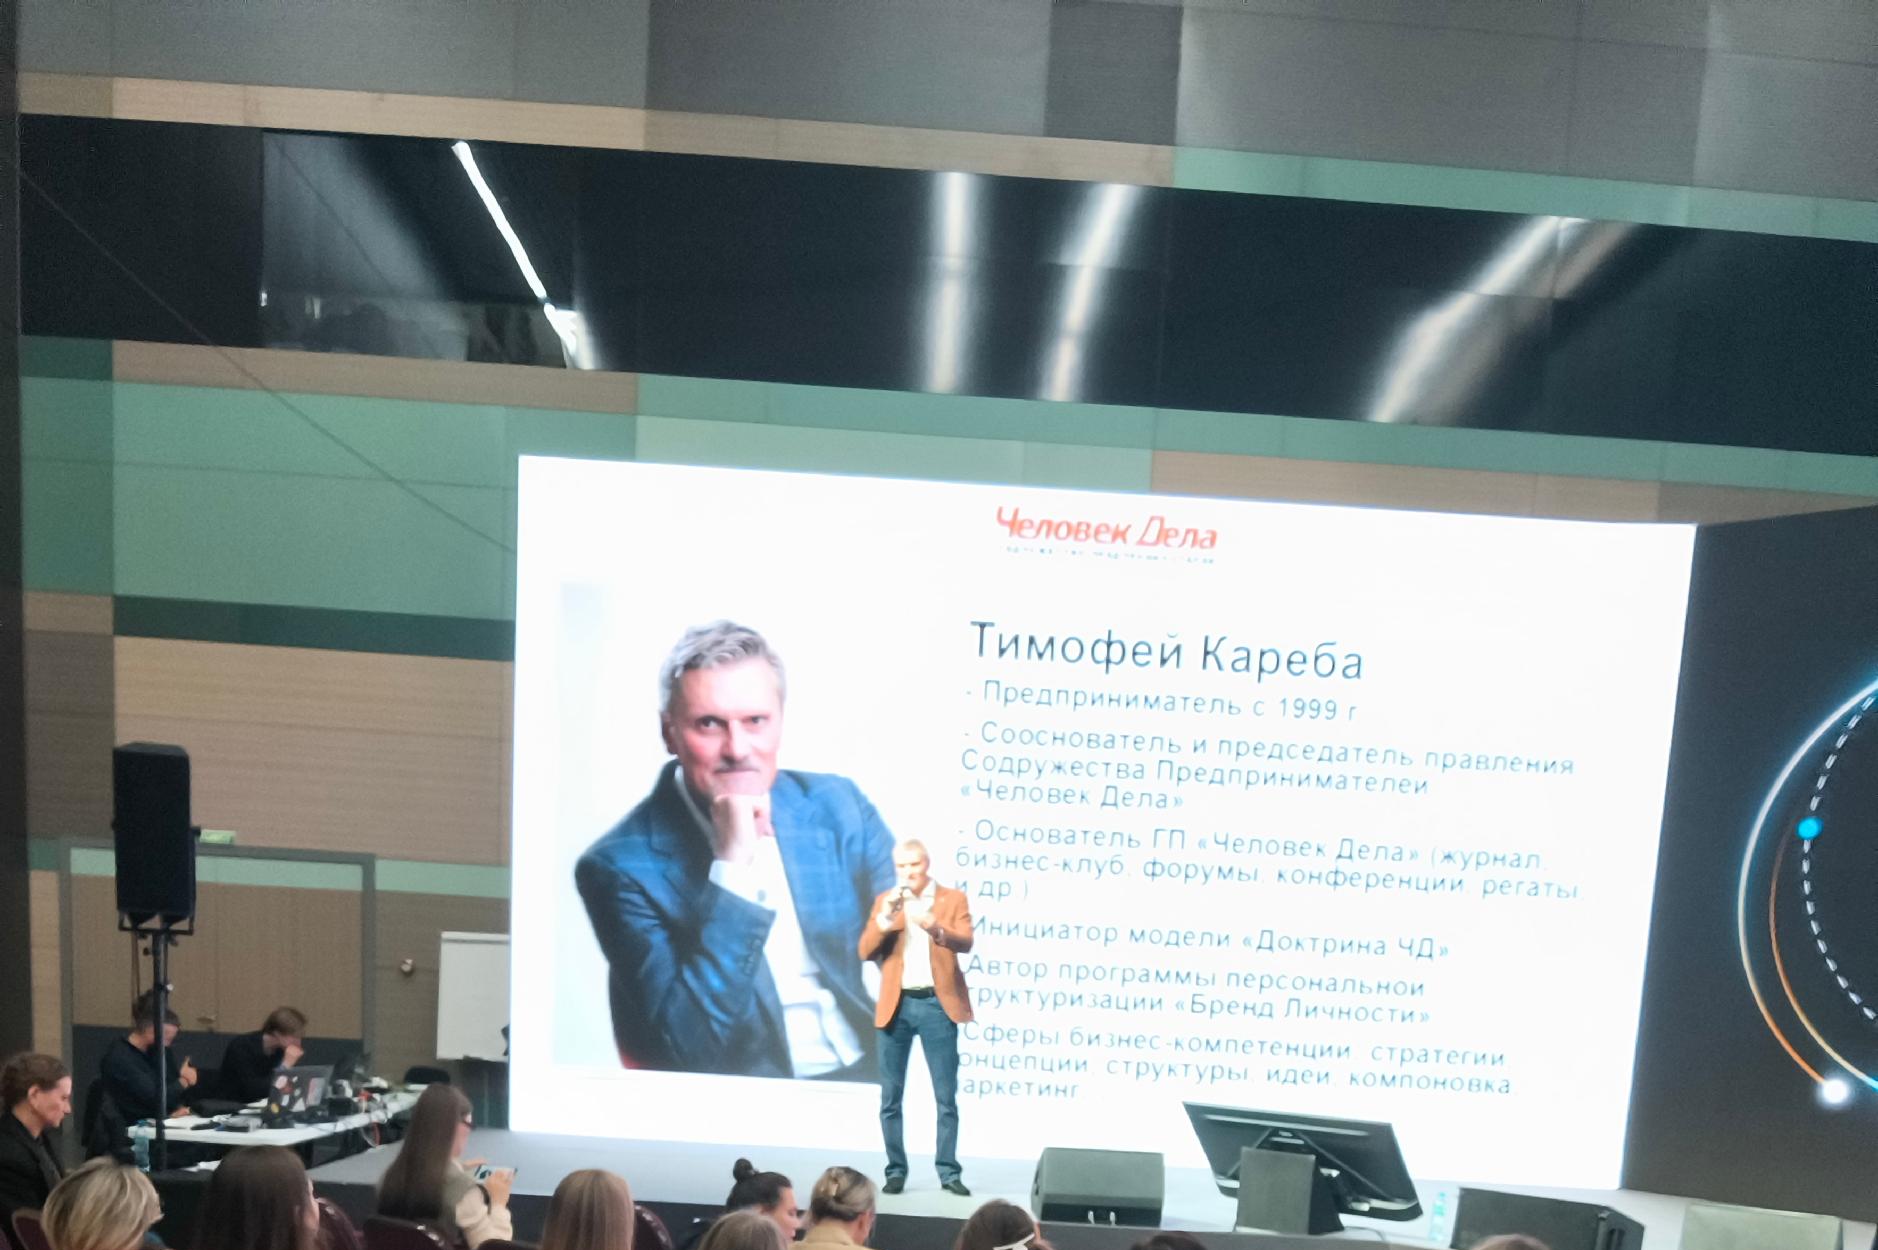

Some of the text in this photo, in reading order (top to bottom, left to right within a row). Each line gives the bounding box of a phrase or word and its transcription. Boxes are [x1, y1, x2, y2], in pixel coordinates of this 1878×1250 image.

[996, 506, 1218, 549] Человек Дела
[970, 621, 1363, 683] Тимофей Кареба
[983, 680, 1242, 716] Предприниматель
[1253, 698, 1265, 716] с
[1280, 697, 1337, 720] 1999
[961, 749, 1145, 780] Содружества
[981, 721, 1181, 754] Сооснователь
[1193, 739, 1207, 753] и
[1218, 739, 1413, 767] председатель
[1425, 751, 1575, 774] правления
[960, 779, 1184, 809] «Человек Дела»
[975, 819, 1141, 848] Основатель
[1153, 828, 1186, 849] ГП
[1197, 832, 1326, 857] «Человек
[1335, 837, 1419, 863] Дела»
[972, 915, 1449, 960] Инициатор модели «Доктрина ЧД»
[965, 954, 1048, 983] Автор
[1059, 962, 1216, 987] программы
[968, 986, 1430, 1023] руктуризации «Бренд Личности»
[964, 1020, 1059, 1048] Сферы
[963, 1079, 1079, 1099] аркетинг
